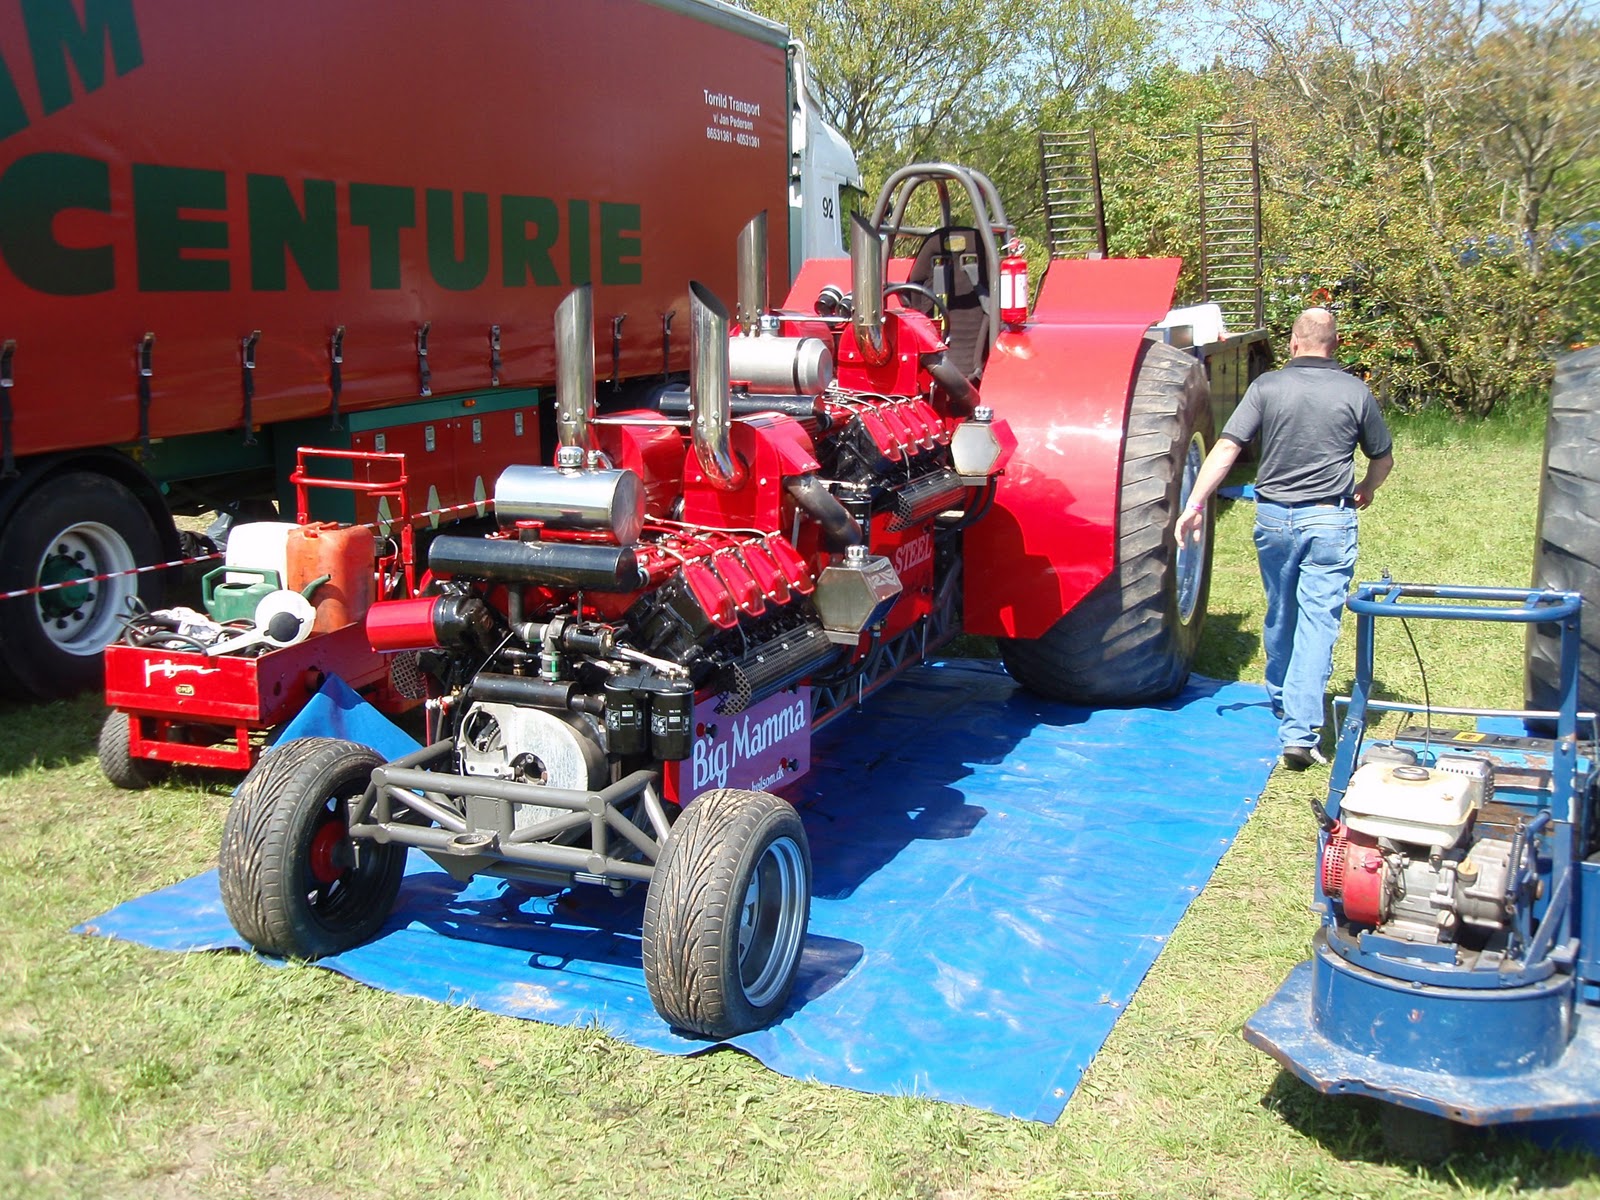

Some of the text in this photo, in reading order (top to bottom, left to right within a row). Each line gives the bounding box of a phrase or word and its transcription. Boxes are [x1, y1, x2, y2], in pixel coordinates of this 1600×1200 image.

[703, 89, 760, 117] Torrild Transport
[719, 113, 729, 126] Jan
[0, 151, 643, 297] CENTURIE
[822, 197, 834, 219] 92
[894, 533, 932, 576] STEEL
[693, 736, 730, 790] Big
[731, 699, 806, 768] Mamma
